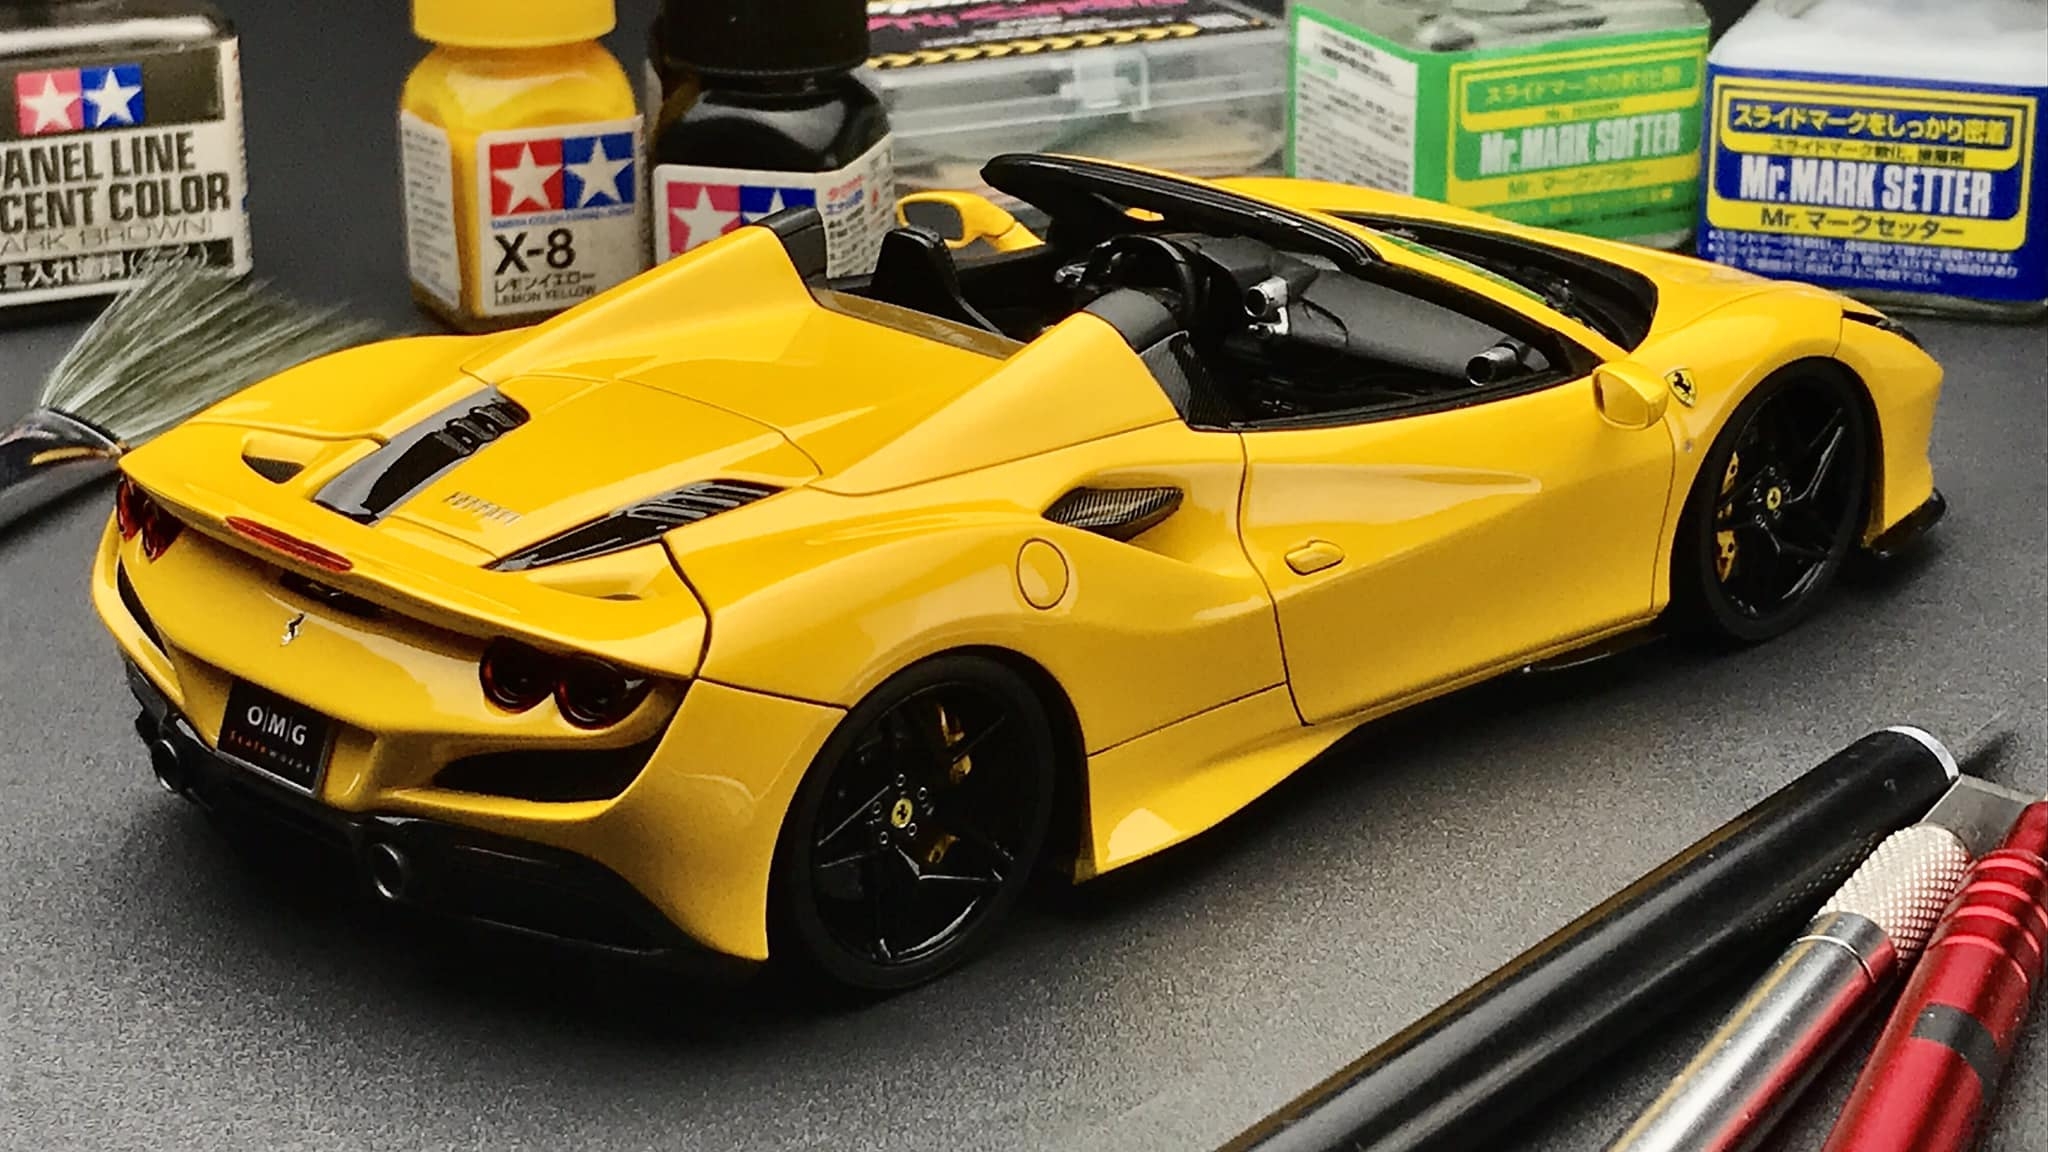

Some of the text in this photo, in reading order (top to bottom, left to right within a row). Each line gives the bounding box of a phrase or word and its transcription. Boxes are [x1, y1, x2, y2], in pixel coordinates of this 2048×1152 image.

[0, 131, 196, 190] ANEL LINE
[1595, 112, 1681, 161] SOFTER
[109, 172, 231, 222] COLOR
[1881, 163, 1993, 217] SETTER
[1760, 208, 1964, 239] Mr. マークセッター
[494, 228, 576, 276] X-8
[494, 271, 596, 294] レモンイエロー
[494, 291, 541, 307] LEMON
